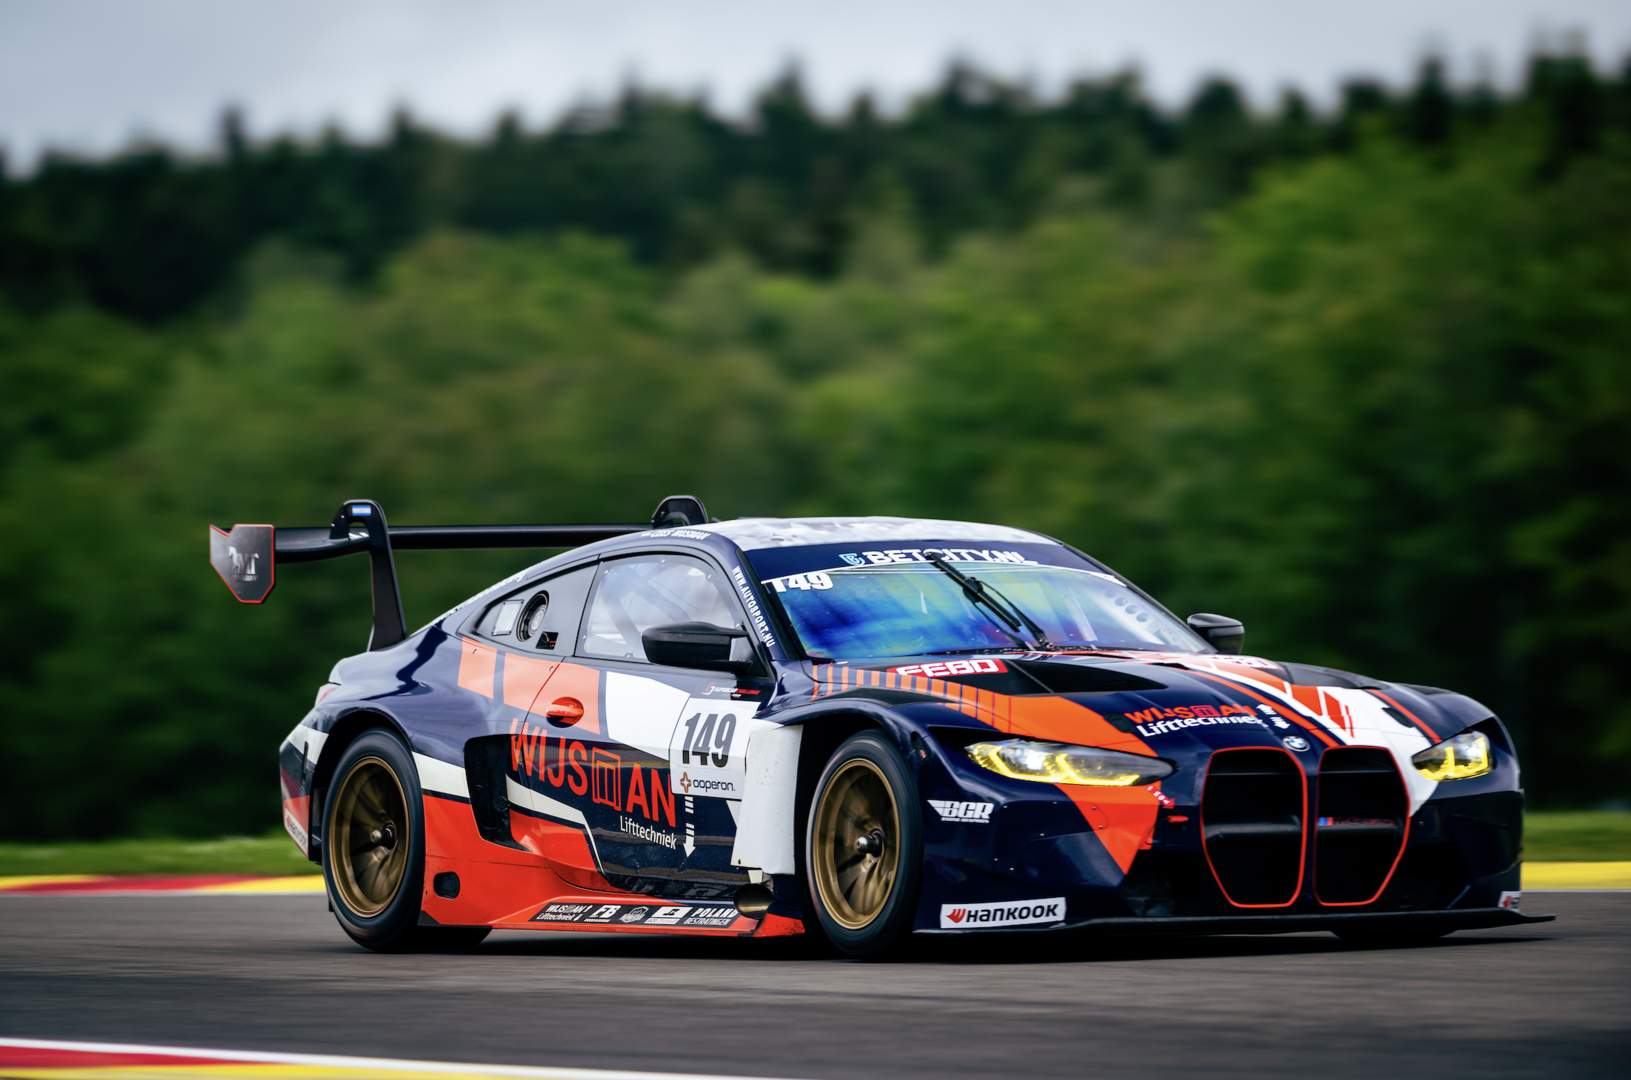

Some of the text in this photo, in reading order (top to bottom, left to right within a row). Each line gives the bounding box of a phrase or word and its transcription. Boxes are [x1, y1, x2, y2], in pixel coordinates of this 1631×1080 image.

[732, 566, 775, 647] WWW.AUTOSPORT.NU
[896, 659, 999, 677] FEBO
[682, 713, 737, 768] 149
[936, 800, 995, 819] BGR
[620, 815, 677, 850] Lifttechniek
[691, 907, 740, 918] POLAND
